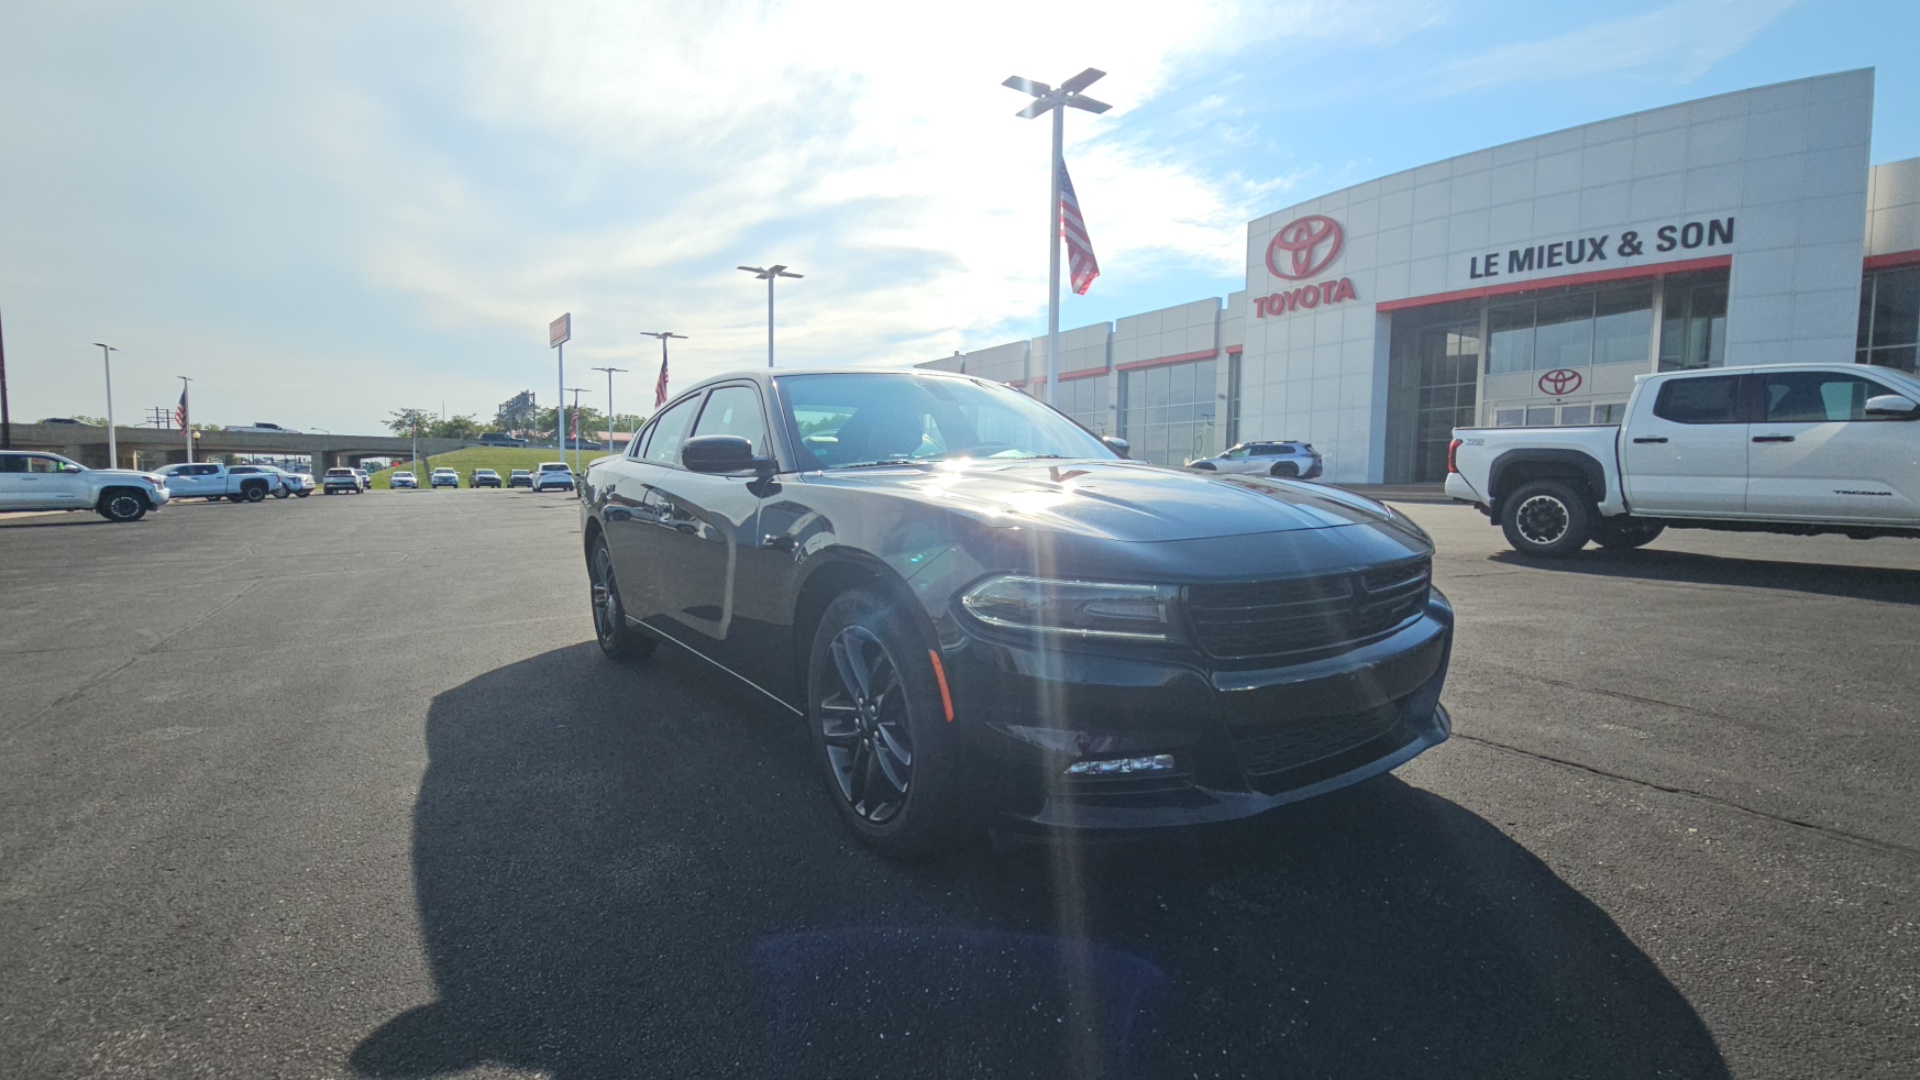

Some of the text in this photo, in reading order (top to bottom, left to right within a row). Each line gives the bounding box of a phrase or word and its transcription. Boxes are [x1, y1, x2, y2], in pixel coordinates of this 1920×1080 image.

[1470, 217, 1735, 279] LE MIEUX & SON
[1253, 277, 1357, 319] TOYOTA
